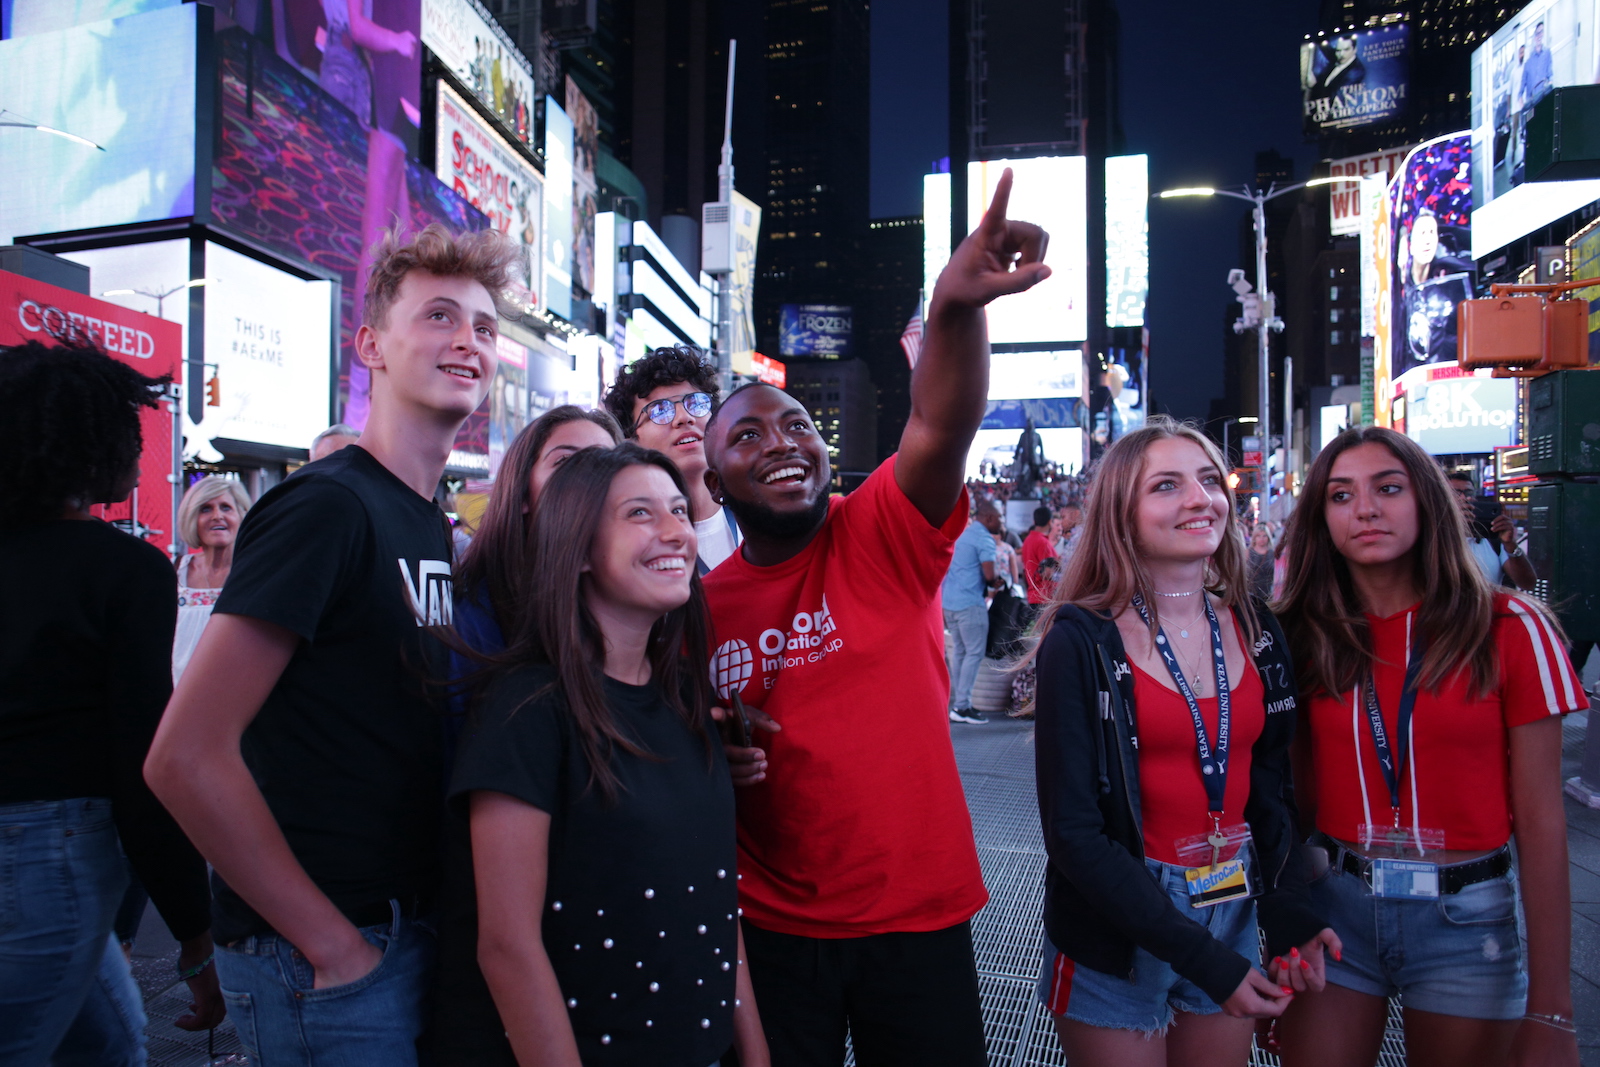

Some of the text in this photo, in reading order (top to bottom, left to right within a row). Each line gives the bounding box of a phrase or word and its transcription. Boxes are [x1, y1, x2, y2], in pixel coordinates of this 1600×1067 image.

[1363, 44, 1405, 57] FANTASIES
[1364, 39, 1404, 51] LET YOUR
[1367, 51, 1401, 62] UNWIND
[1304, 83, 1406, 116] PHANTOM
[1341, 82, 1366, 95] THE
[1312, 112, 1330, 122] OF
[1330, 105, 1356, 119] THE
[1356, 100, 1397, 115] OPERA
[452, 130, 513, 212] SCHOOL
[18, 300, 155, 359] COFFEED
[235, 317, 282, 345] THIS IS
[799, 313, 852, 333] FROZEN
[232, 340, 284, 368] #AExME
[1361, 356, 1375, 425] EXPERIENCE
[1426, 381, 1483, 415] 8K
[397, 558, 453, 627] VAN
[1173, 670, 1210, 760] KEAN UNIVERSITY
[1216, 662, 1230, 753] KEAN UNIVERSITY
[1187, 862, 1239, 897] MetroCard
[1392, 862, 1436, 872] KEAN UNIVERSITY
